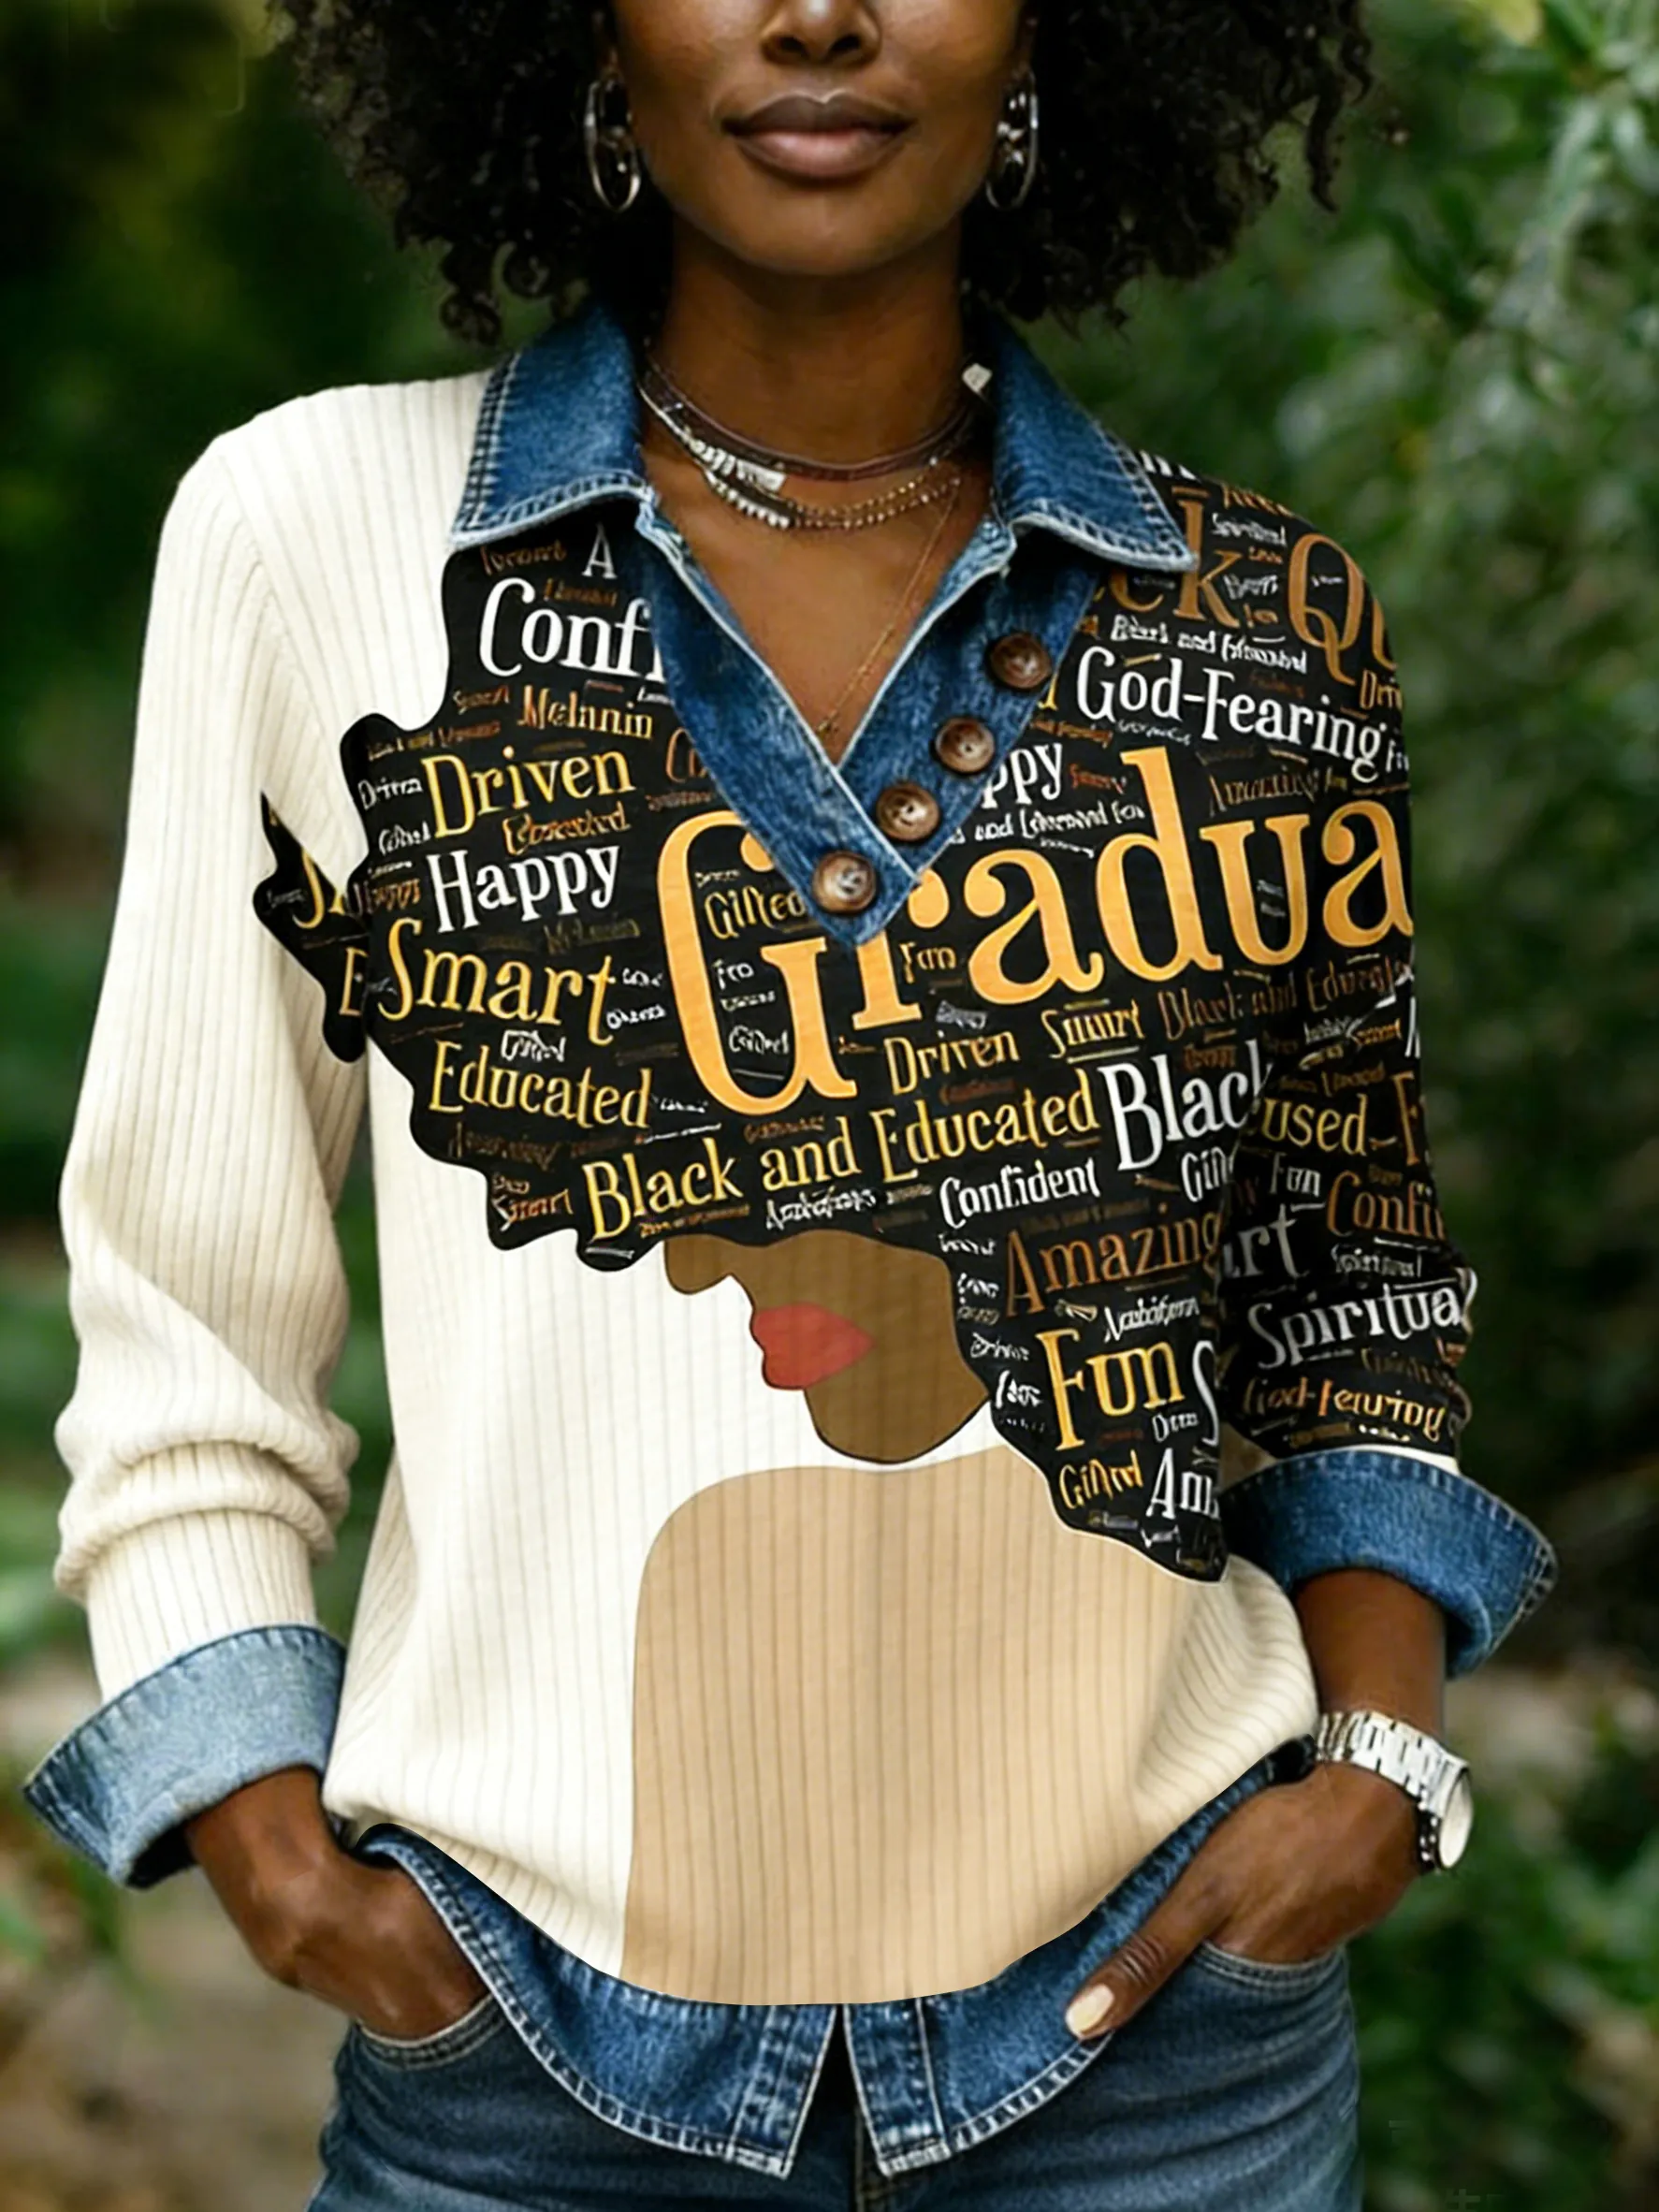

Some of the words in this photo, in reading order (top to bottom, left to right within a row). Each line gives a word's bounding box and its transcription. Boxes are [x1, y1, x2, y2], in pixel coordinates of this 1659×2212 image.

[420, 745, 637, 839] Driven
[425, 845, 620, 934] Happy
[377, 917, 617, 1046] Smart
[429, 1040, 653, 1129] Educated
[581, 1136, 745, 1243] Black
[760, 1115, 862, 1192] and
[868, 1068, 1102, 1184] Educated
[939, 1157, 1102, 1230] Confident
[1034, 1327, 1186, 1451] Fun
